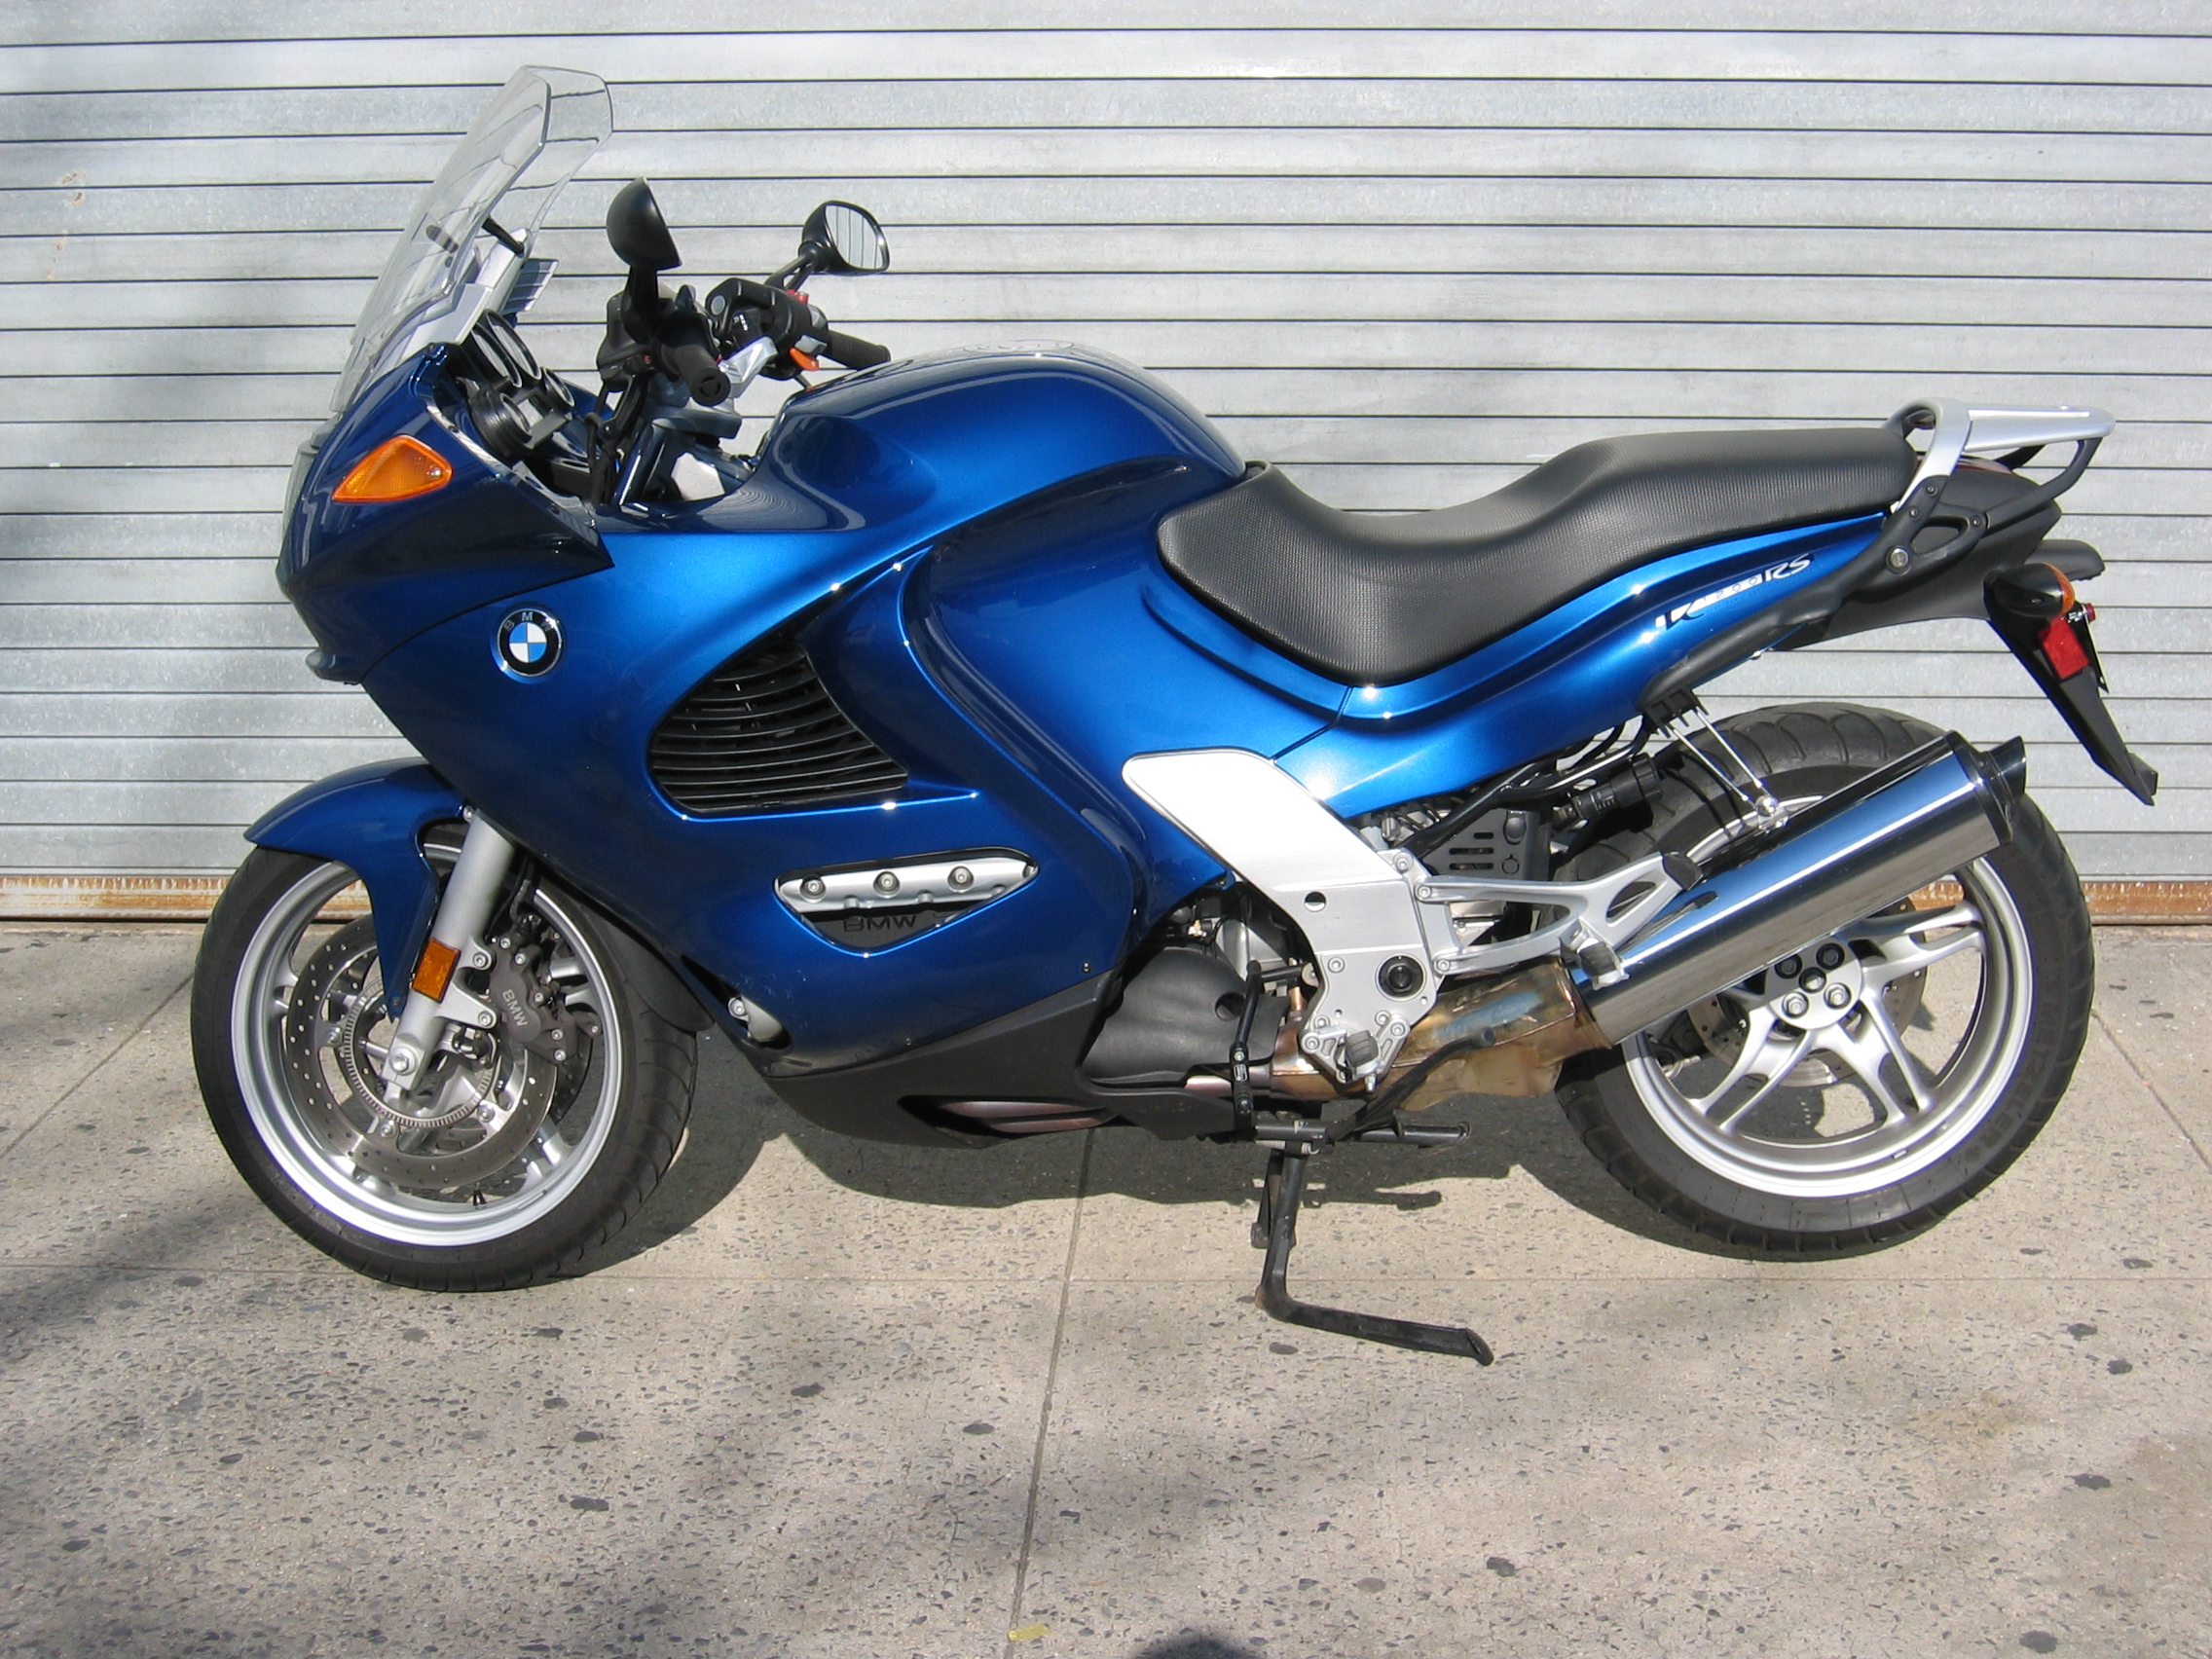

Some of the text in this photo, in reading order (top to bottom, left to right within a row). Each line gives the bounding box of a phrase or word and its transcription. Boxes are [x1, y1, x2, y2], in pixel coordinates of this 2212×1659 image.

[504, 611, 554, 633] BMW
[845, 914, 917, 932] BMW
[502, 989, 529, 1026] BMW
